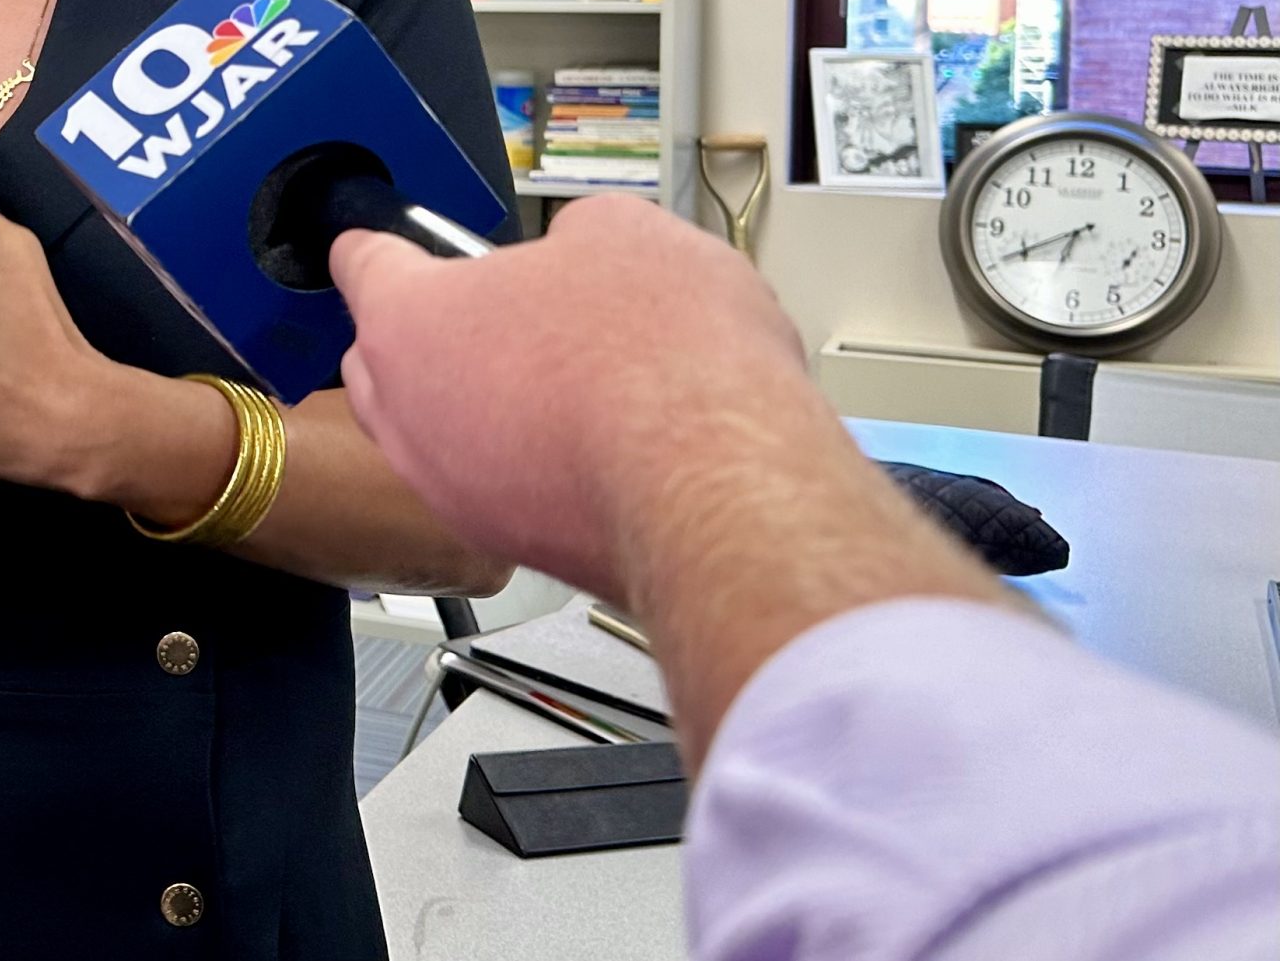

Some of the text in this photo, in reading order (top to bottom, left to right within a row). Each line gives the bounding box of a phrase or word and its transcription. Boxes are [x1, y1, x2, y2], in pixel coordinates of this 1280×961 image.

[60, 23, 216, 162] 10
[117, 18, 320, 179] WJAR
[1025, 166, 1053, 188] 11
[1066, 157, 1096, 178] 12
[1117, 172, 1130, 193] 1
[1002, 187, 1031, 209] 10
[1139, 196, 1154, 218] 2
[989, 216, 1004, 238] 9
[1151, 229, 1166, 251] 3
[1065, 289, 1080, 310] 6
[1106, 283, 1121, 306] 5
